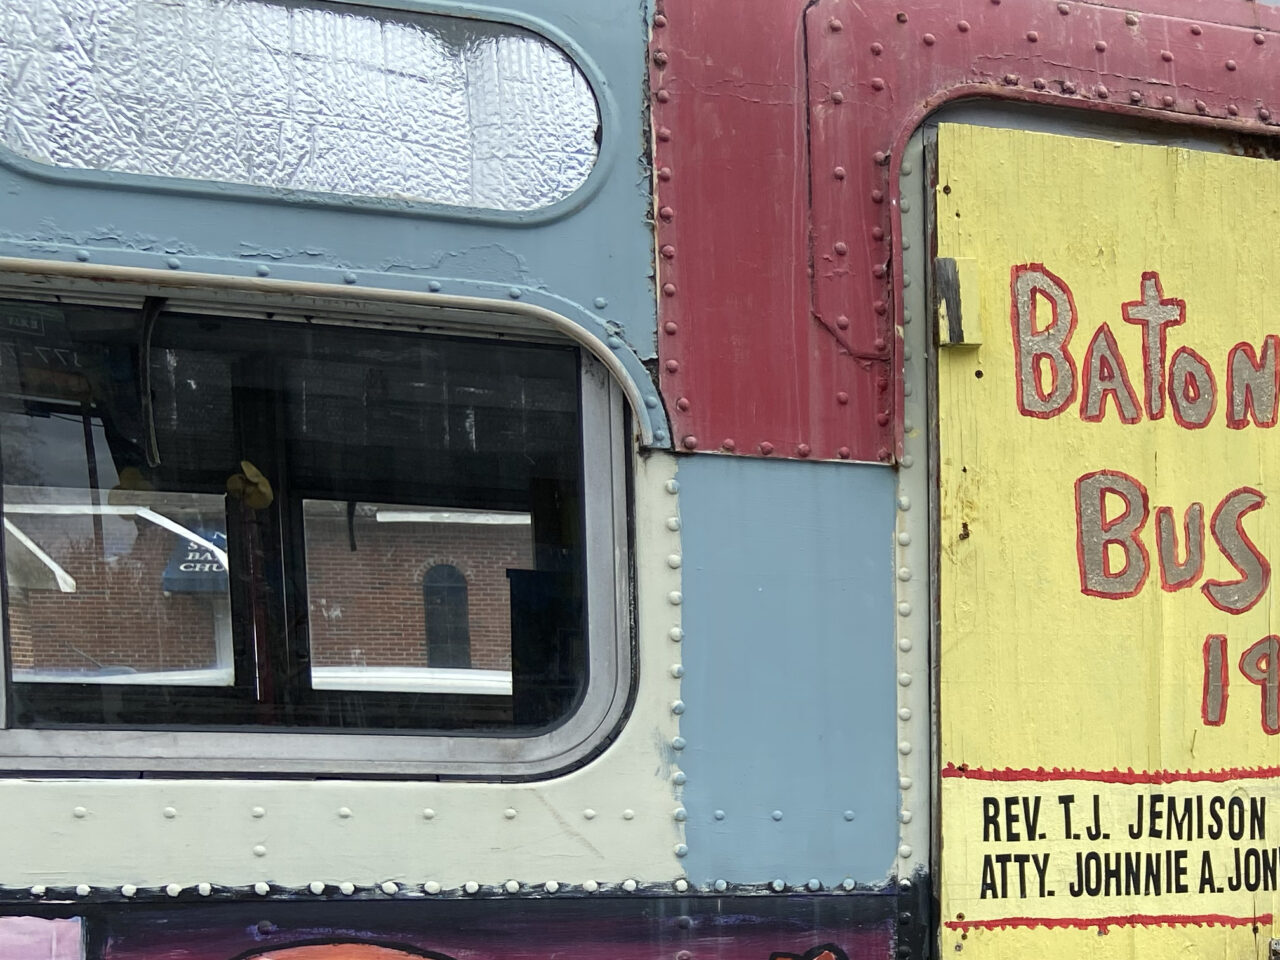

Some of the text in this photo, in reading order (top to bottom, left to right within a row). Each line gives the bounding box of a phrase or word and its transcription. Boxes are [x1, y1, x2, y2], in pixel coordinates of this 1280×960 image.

[984, 796, 1047, 841] REV.
[1128, 794, 1265, 841] JEMISON
[981, 852, 1055, 899] ATTY.
[1070, 850, 1188, 897] JOHNNIE
